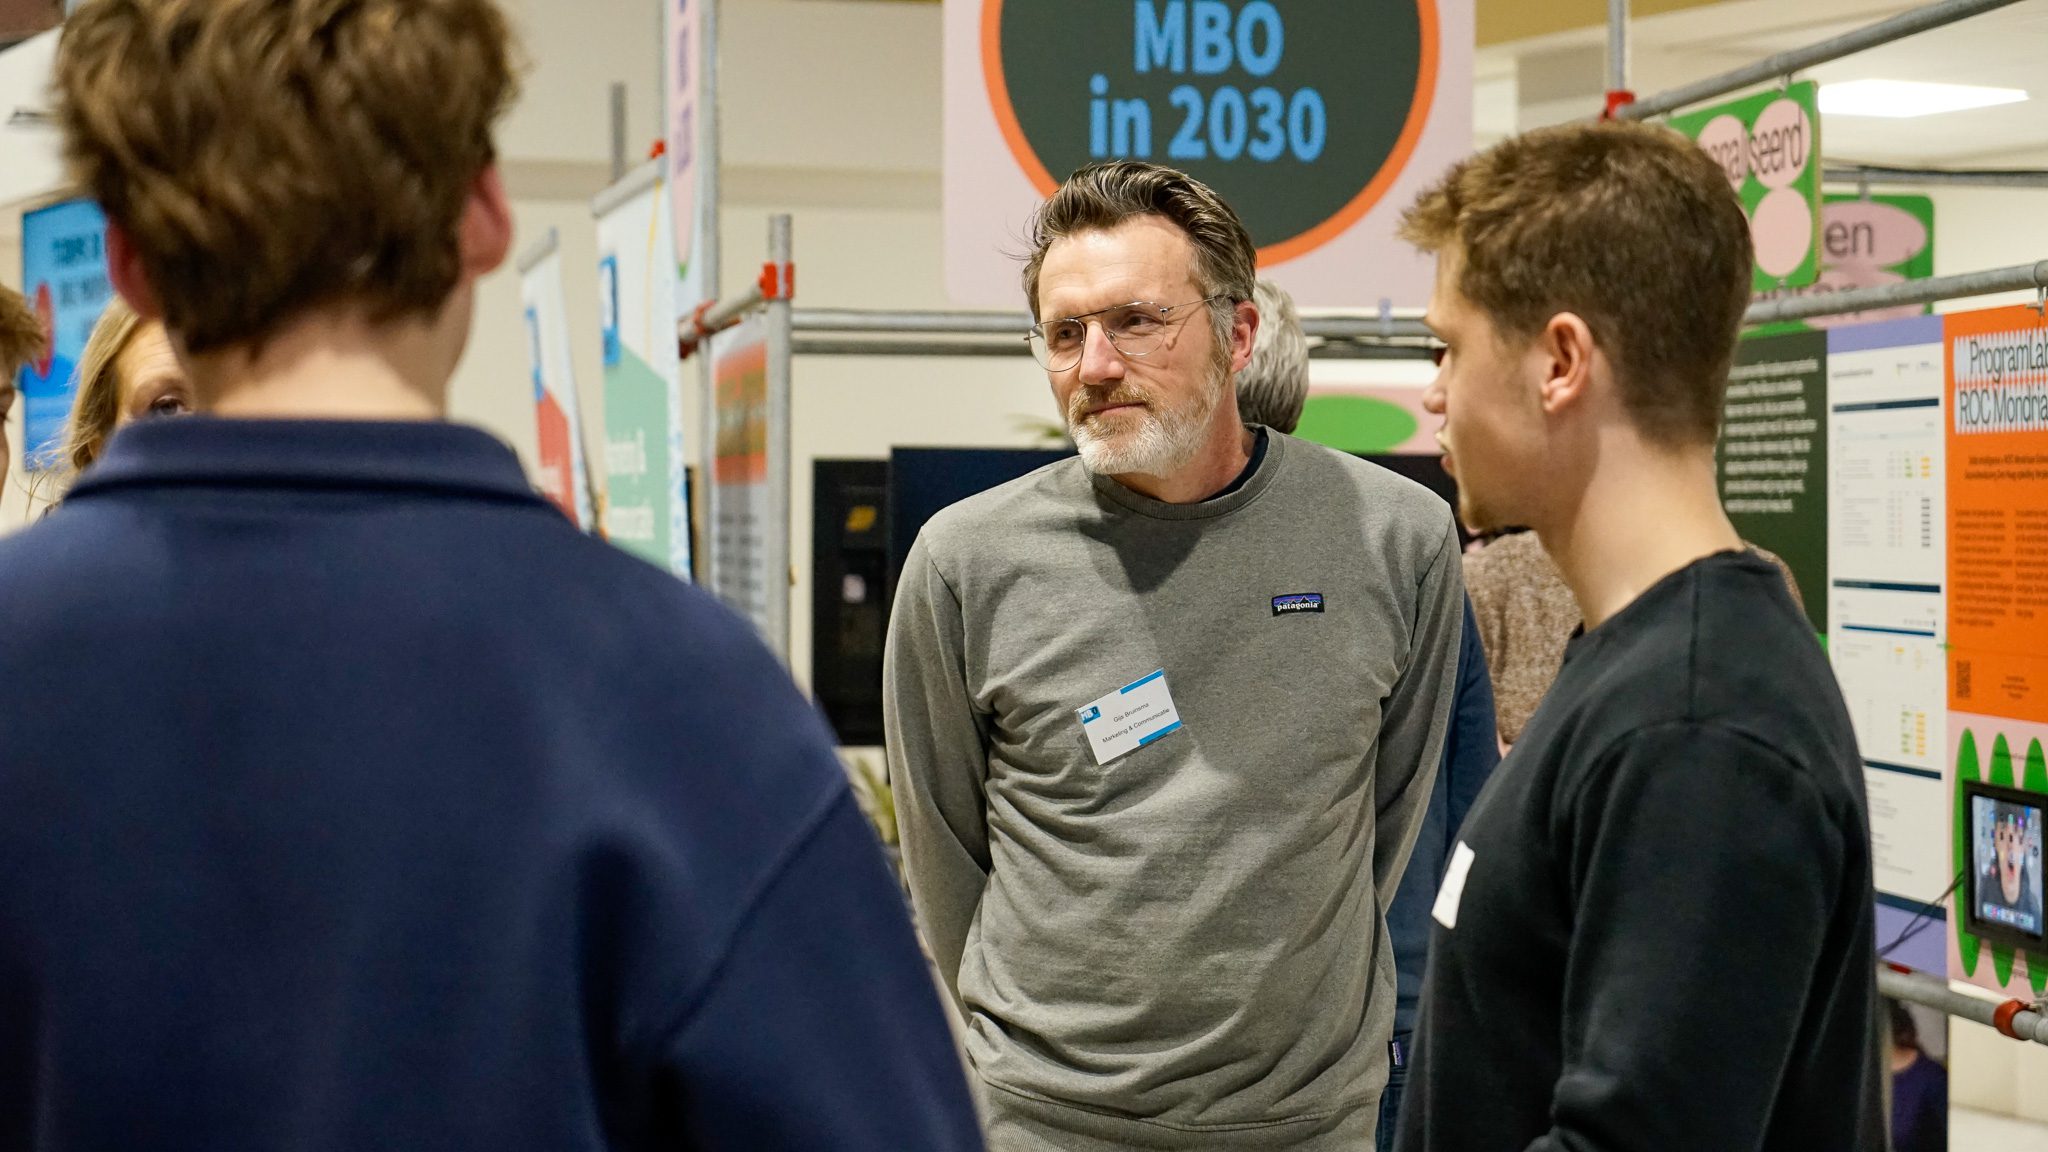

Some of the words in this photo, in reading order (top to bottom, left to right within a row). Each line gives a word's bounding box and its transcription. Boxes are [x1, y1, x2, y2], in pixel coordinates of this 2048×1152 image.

[1133, 0, 1285, 77] MBO
[1089, 73, 1151, 158] in
[1167, 84, 1327, 163] 2030
[1959, 389, 1992, 425] ROC
[1277, 601, 1318, 612] patagonia
[1102, 728, 1128, 743] Marketing
[1134, 708, 1170, 728] Communicatie
